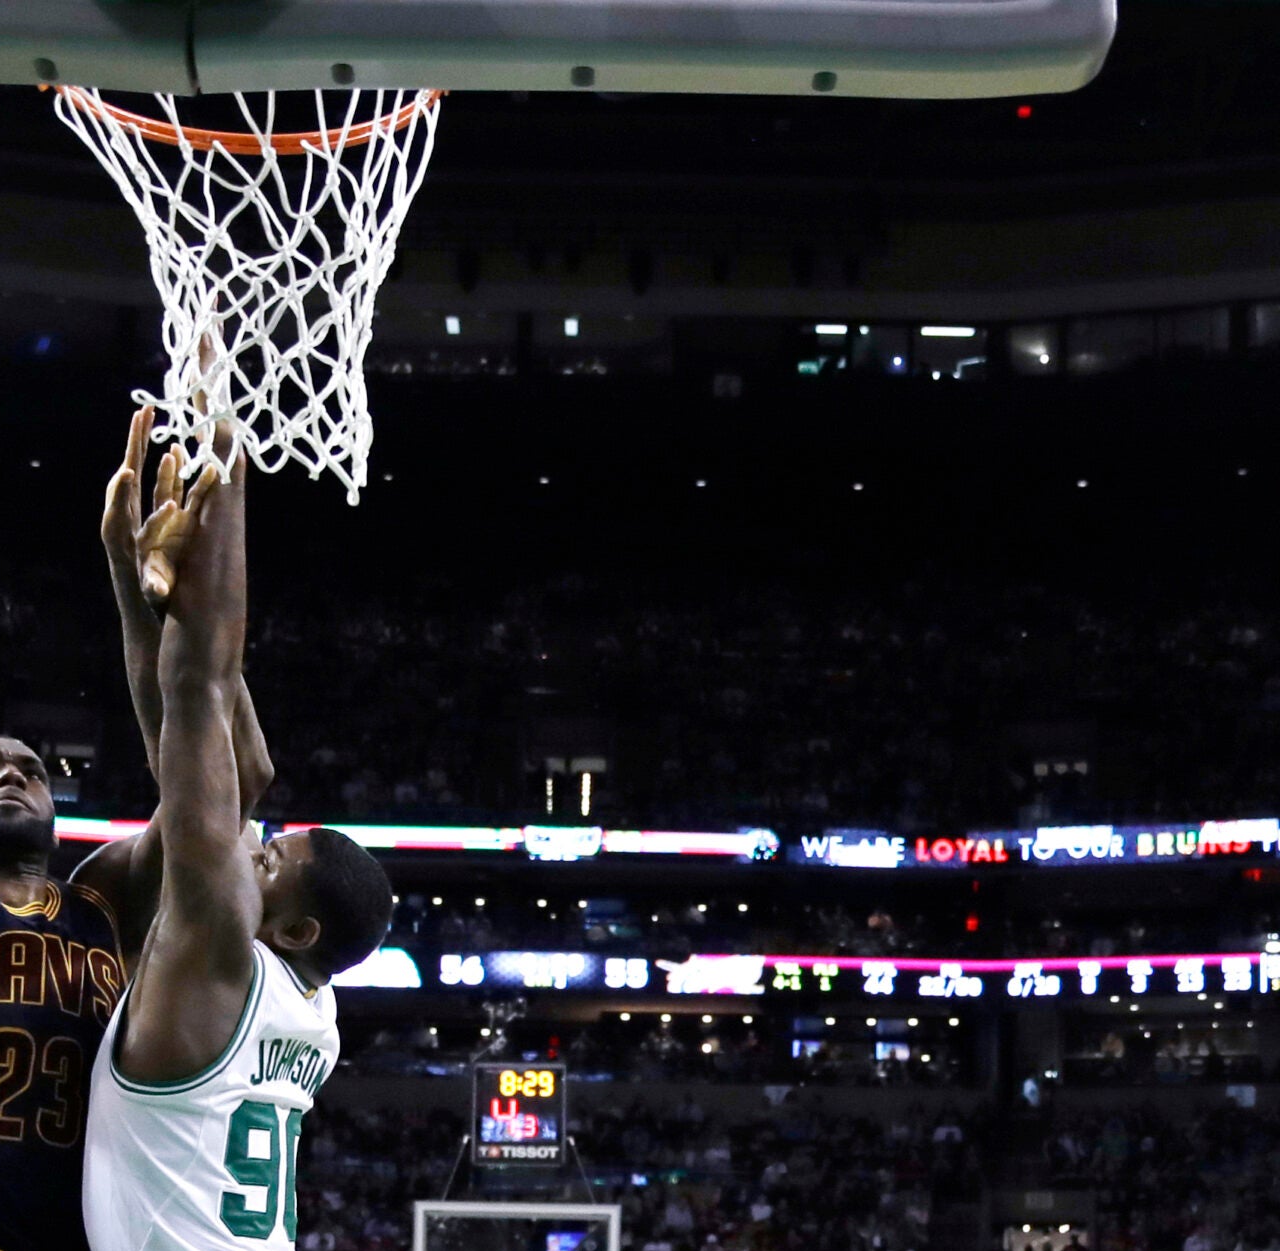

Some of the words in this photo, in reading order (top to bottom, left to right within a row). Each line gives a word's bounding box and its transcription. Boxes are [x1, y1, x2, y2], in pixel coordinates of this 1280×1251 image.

[914, 837, 1009, 863] LOYAL
[1017, 837, 1055, 861] TO
[250, 1038, 328, 1099] JOHNSON
[499, 1069, 555, 1097] 8:29
[500, 1145, 559, 1159] TISSOT
